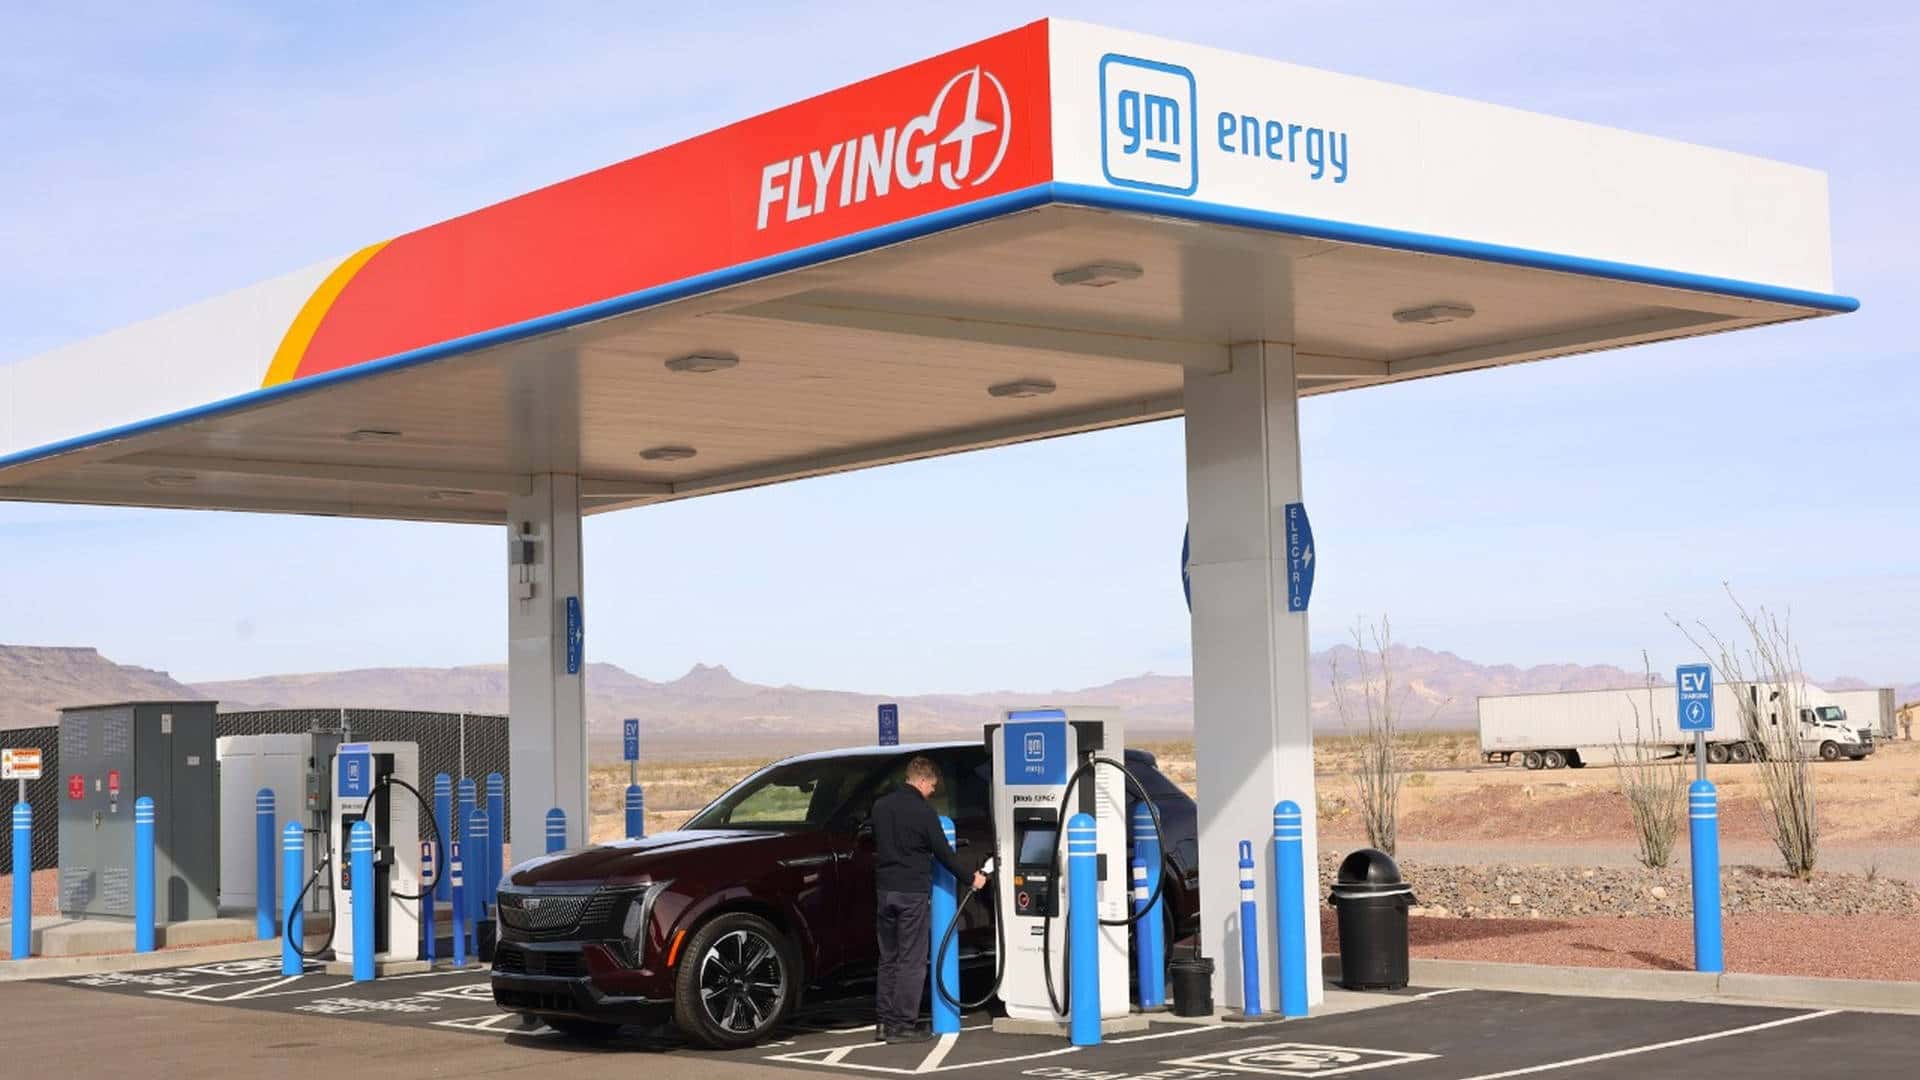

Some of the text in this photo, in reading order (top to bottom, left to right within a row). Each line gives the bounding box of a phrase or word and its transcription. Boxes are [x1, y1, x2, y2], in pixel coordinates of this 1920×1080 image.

[756, 113, 940, 231] FLYING
[1118, 88, 1349, 183] gm energy
[1291, 508, 1301, 607] ELECTRIC
[626, 722, 637, 736] EV
[1681, 672, 1706, 692] EV
